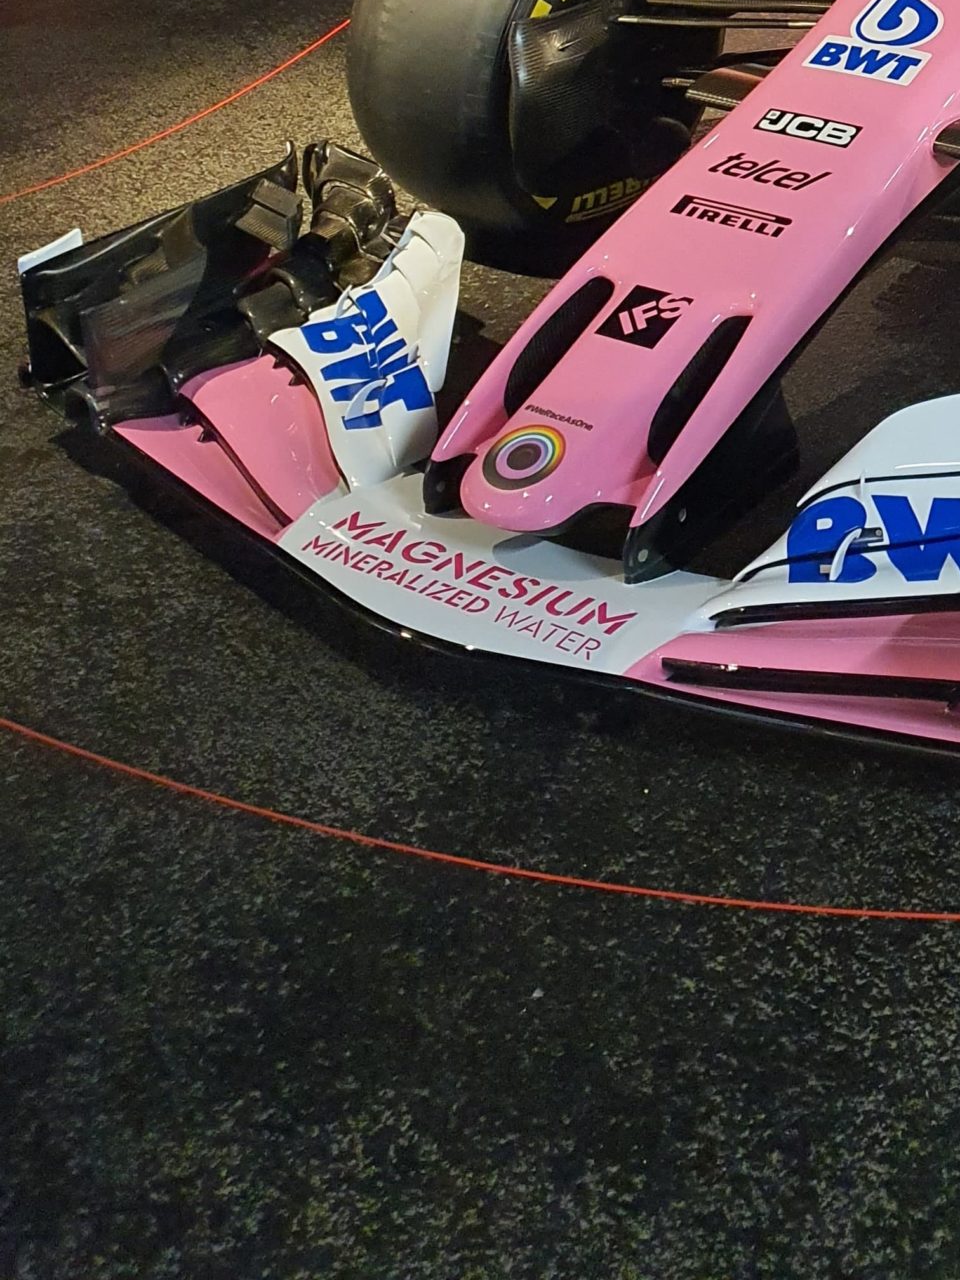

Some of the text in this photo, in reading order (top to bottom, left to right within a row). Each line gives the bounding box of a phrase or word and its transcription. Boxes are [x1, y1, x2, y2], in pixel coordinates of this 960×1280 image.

[809, 41, 922, 81] BWT
[759, 110, 857, 146] JCB
[708, 152, 832, 191] telcel
[669, 194, 793, 238] PIRELLI
[618, 295, 694, 335] IFS
[300, 290, 434, 430] BWT
[524, 404, 594, 431] #WeRaceAsOne
[332, 511, 639, 635] MAGNESIUM
[302, 535, 602, 661] MINERALIZED WATER
